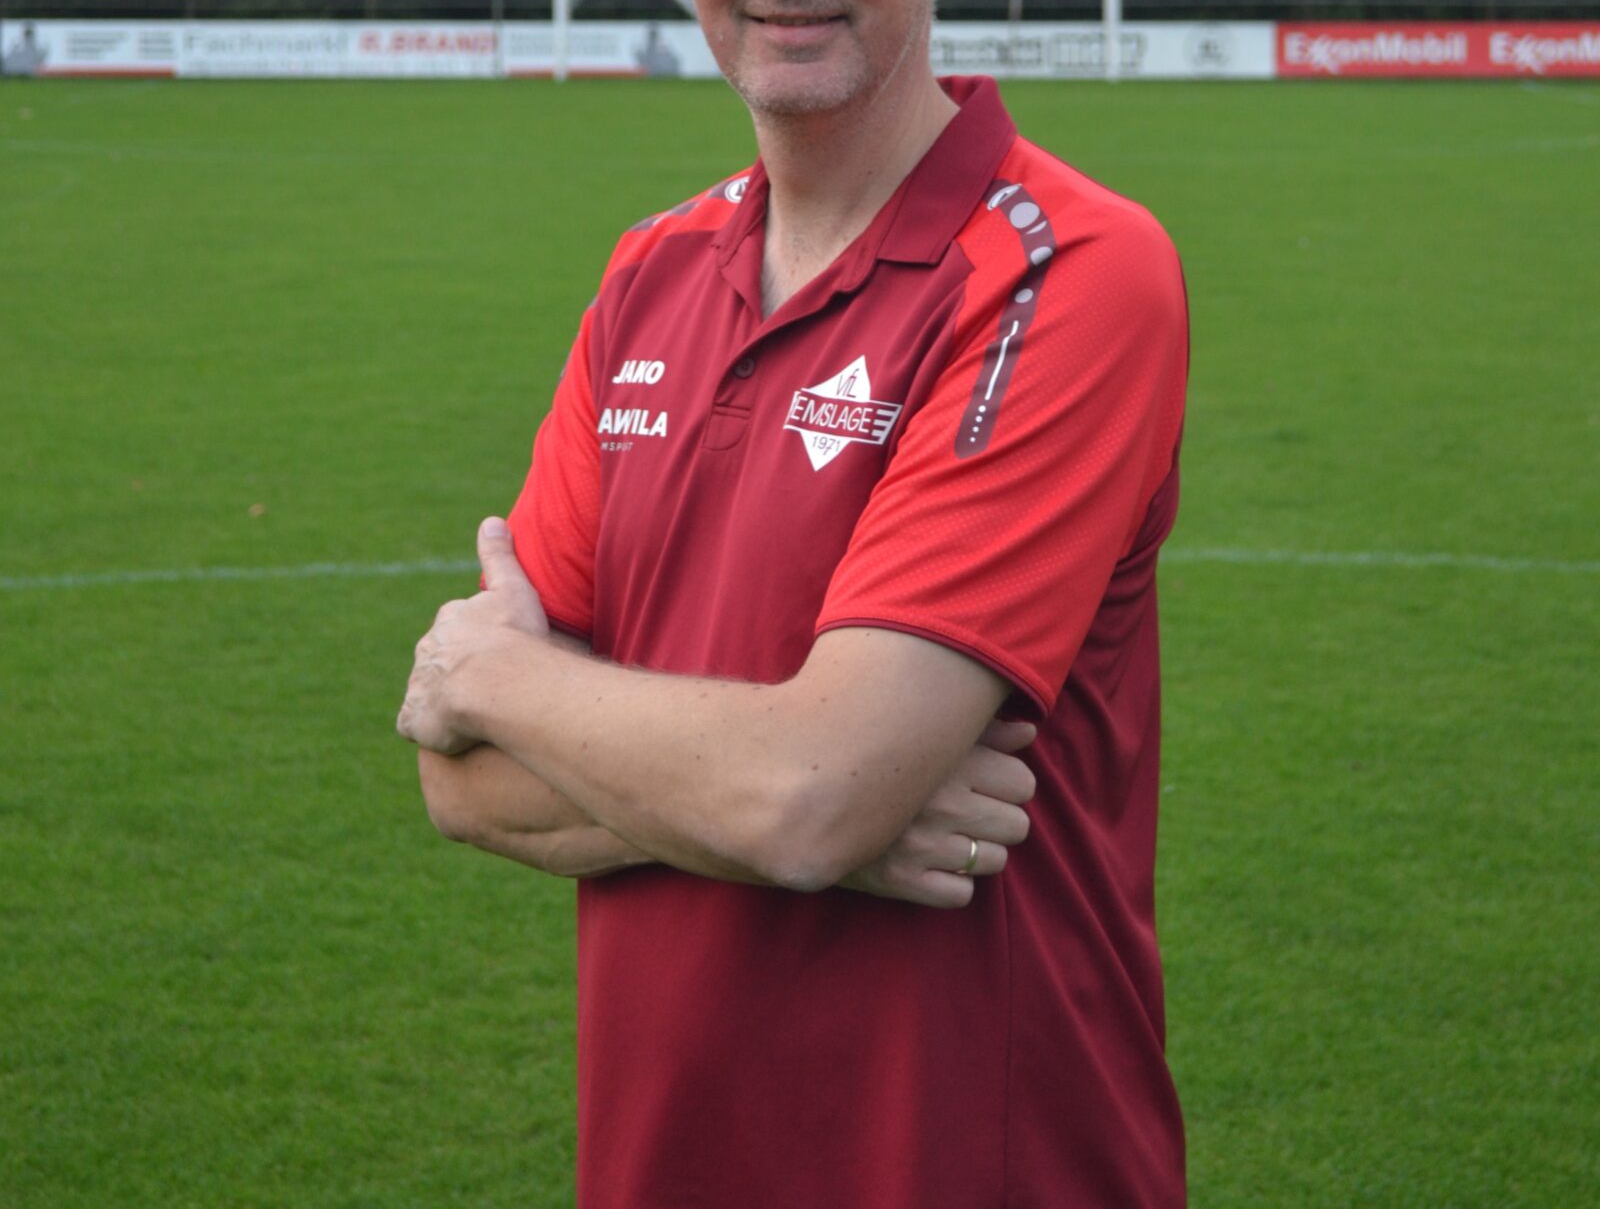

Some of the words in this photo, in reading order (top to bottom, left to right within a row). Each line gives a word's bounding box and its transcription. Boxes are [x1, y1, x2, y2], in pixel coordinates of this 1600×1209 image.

[1284, 31, 1468, 74] ExxonMobil
[612, 359, 666, 384] JAKO
[790, 395, 873, 434] EMSLAGE
[812, 435, 841, 456] 1971
